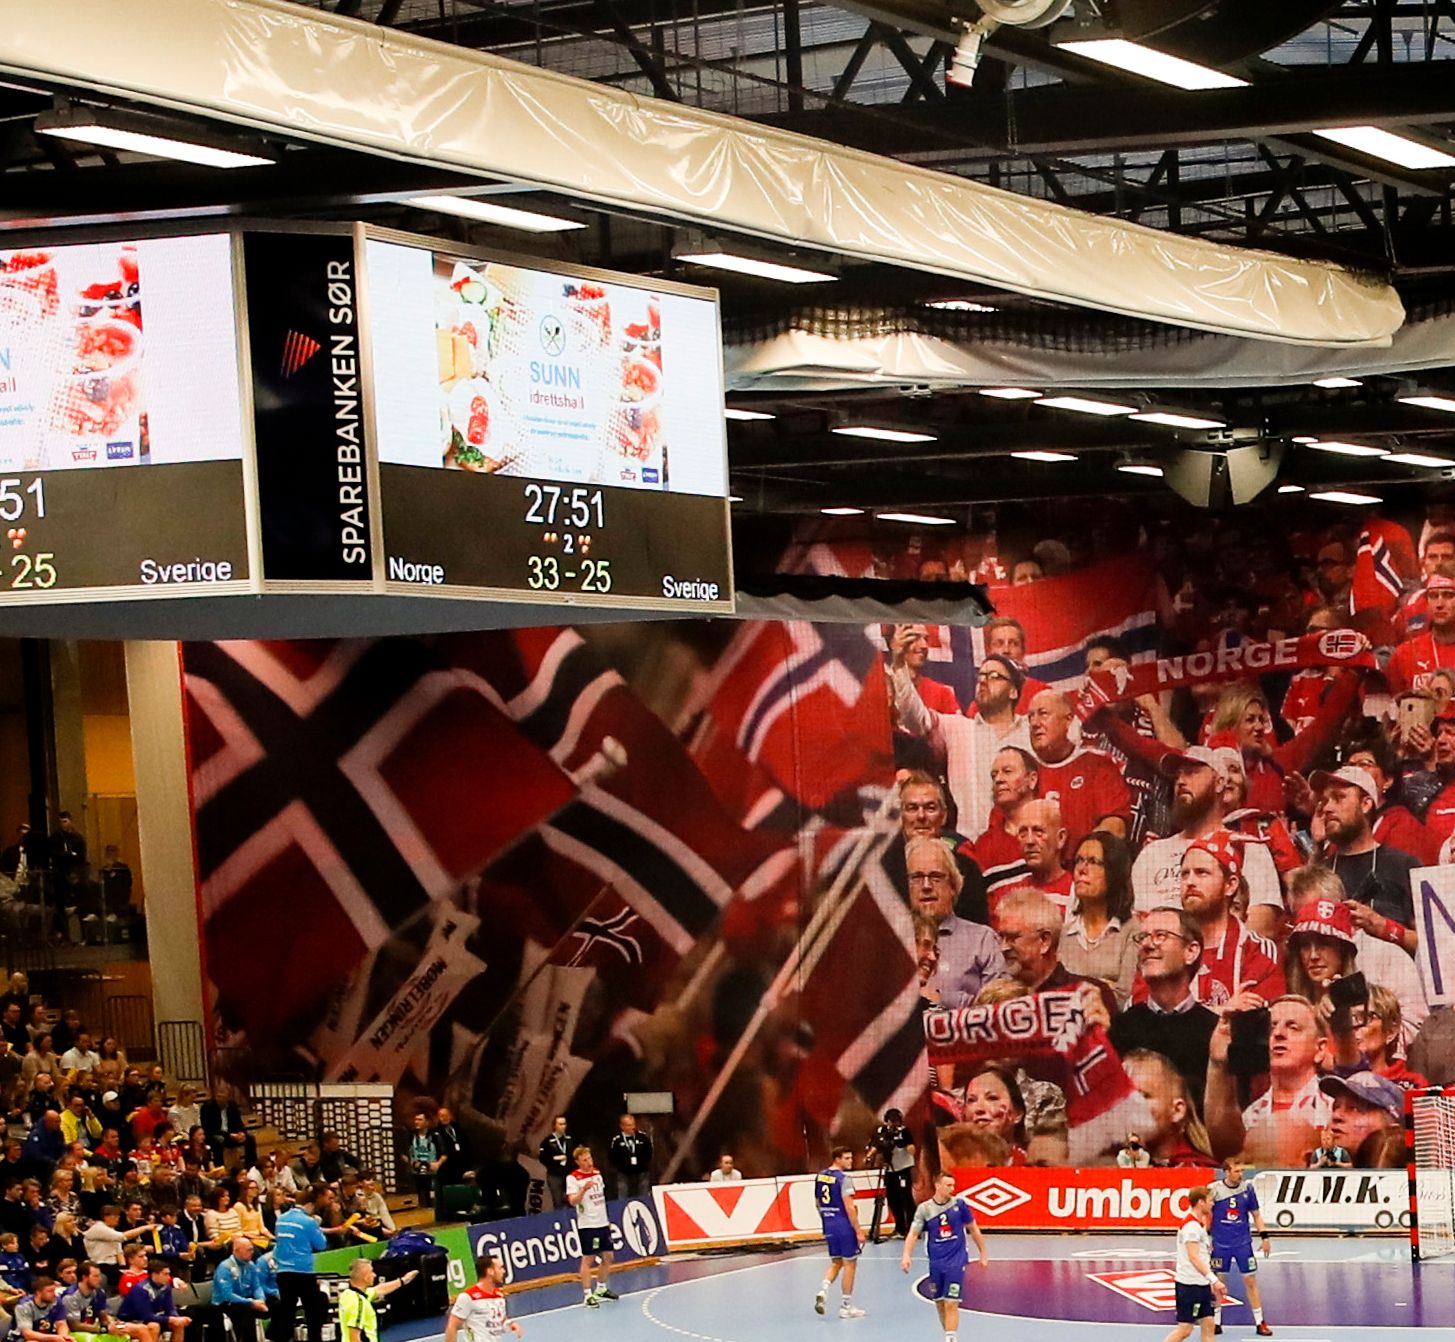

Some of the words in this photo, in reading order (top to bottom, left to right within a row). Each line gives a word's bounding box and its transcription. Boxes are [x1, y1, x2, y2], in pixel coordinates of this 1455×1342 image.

[327, 261, 352, 324] SØR
[530, 361, 581, 389] SUNN
[330, 335, 366, 564] SPAREBANKEN
[525, 484, 604, 528] 27:51
[563, 533, 574, 554] 2
[11, 553, 57, 589] 25
[140, 556, 232, 583] Sverige
[389, 556, 444, 584] Norge
[528, 555, 560, 590] 33
[581, 560, 612, 593] 25
[662, 575, 719, 600] Sverige
[1157, 637, 1298, 684] NORGE
[821, 1185, 831, 1204] 3
[1047, 1178, 1193, 1219] umbro
[1229, 1197, 1237, 1209] 5
[1276, 1175, 1391, 1205] H.M.K.
[939, 1214, 948, 1226] 2
[477, 1219, 624, 1285] Gjenside
